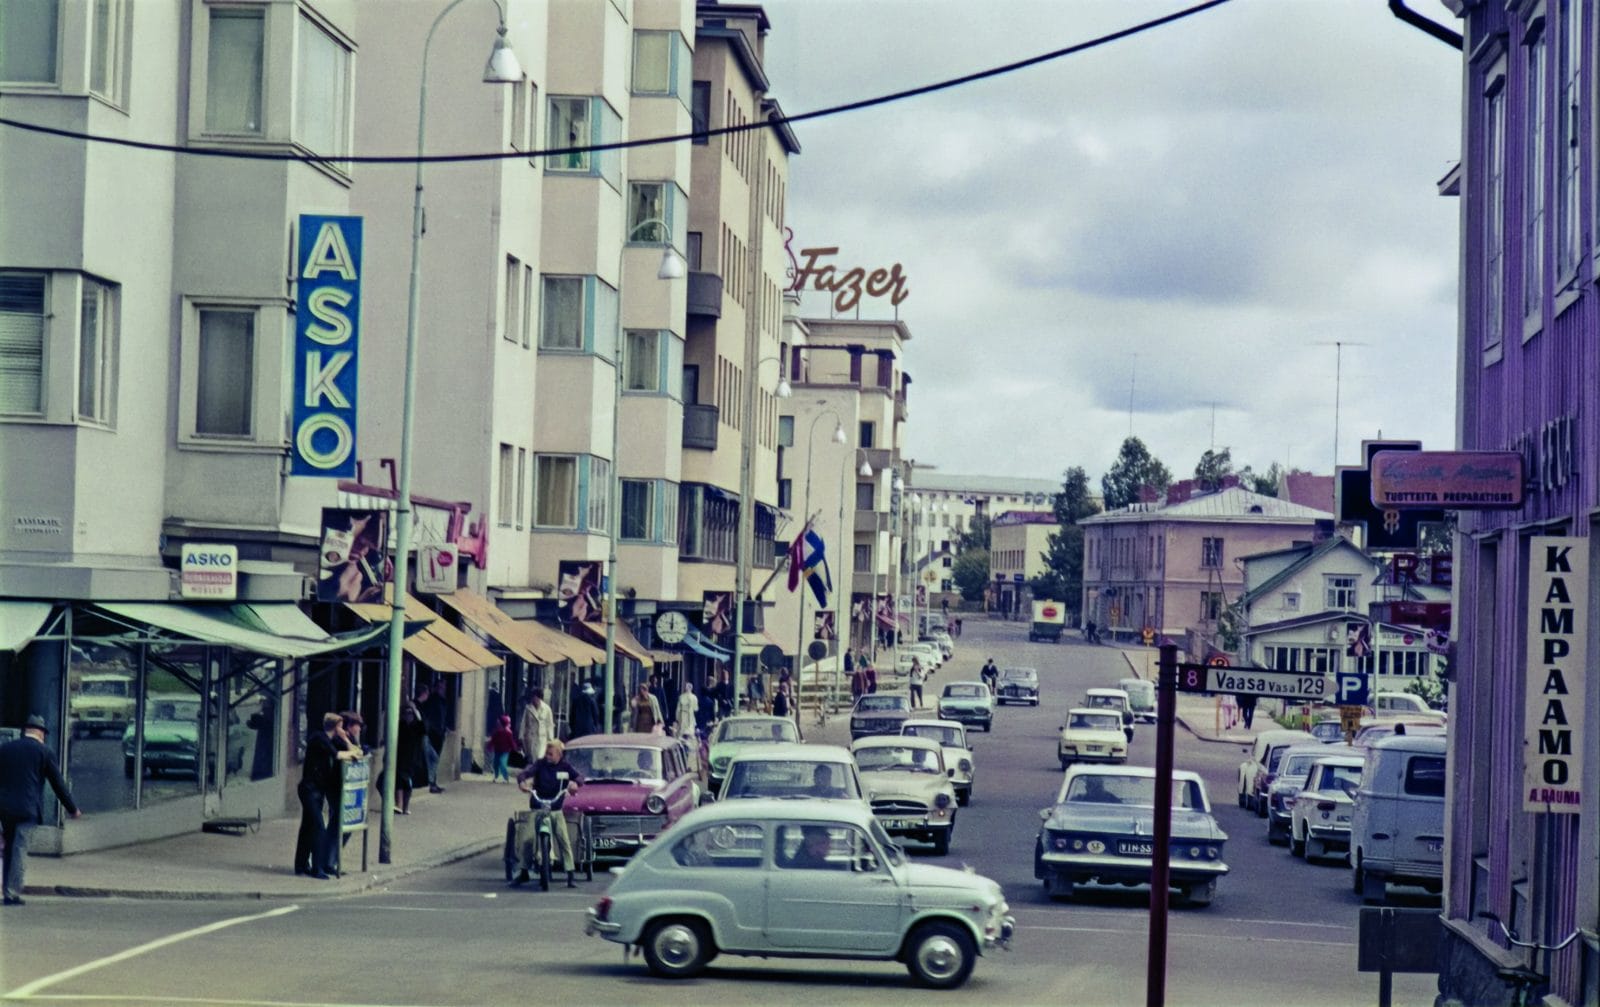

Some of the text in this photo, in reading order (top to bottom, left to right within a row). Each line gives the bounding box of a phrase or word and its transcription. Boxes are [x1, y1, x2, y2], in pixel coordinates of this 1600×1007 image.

[794, 246, 910, 313] Fazer
[296, 221, 359, 471] ASKO
[1384, 491, 1514, 502] TUOTTEITA PREPARATIONS
[185, 552, 233, 567] ASKO
[1538, 545, 1575, 786] KAMPAAMO
[1187, 670, 1325, 695] 8 Vaasa Vasa 129
[1341, 676, 1362, 701] P
